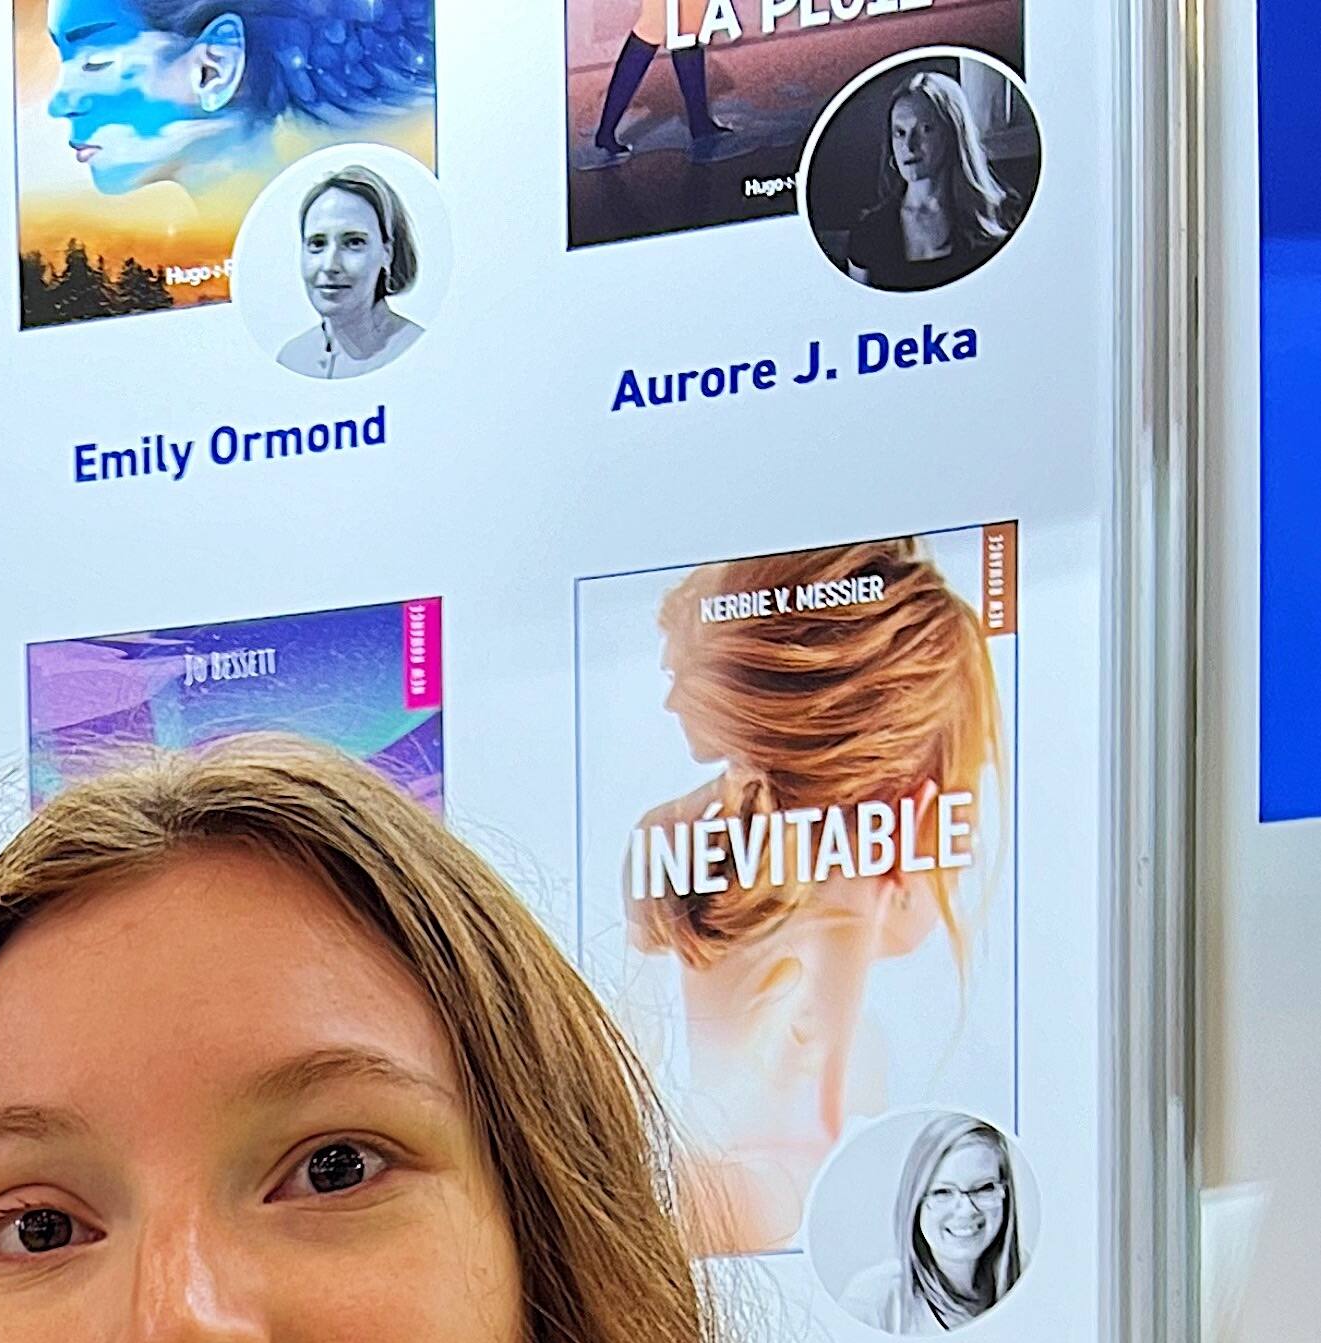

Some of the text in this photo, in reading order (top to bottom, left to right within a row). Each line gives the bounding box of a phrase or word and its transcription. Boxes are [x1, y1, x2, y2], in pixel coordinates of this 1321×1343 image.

[611, 323, 978, 412] Aurore J. Deka
[73, 404, 387, 482] Emily Ormond
[700, 586, 773, 624] KERBIE
[796, 574, 885, 611] MESSIER
[631, 791, 975, 899] INÉVITABLE
